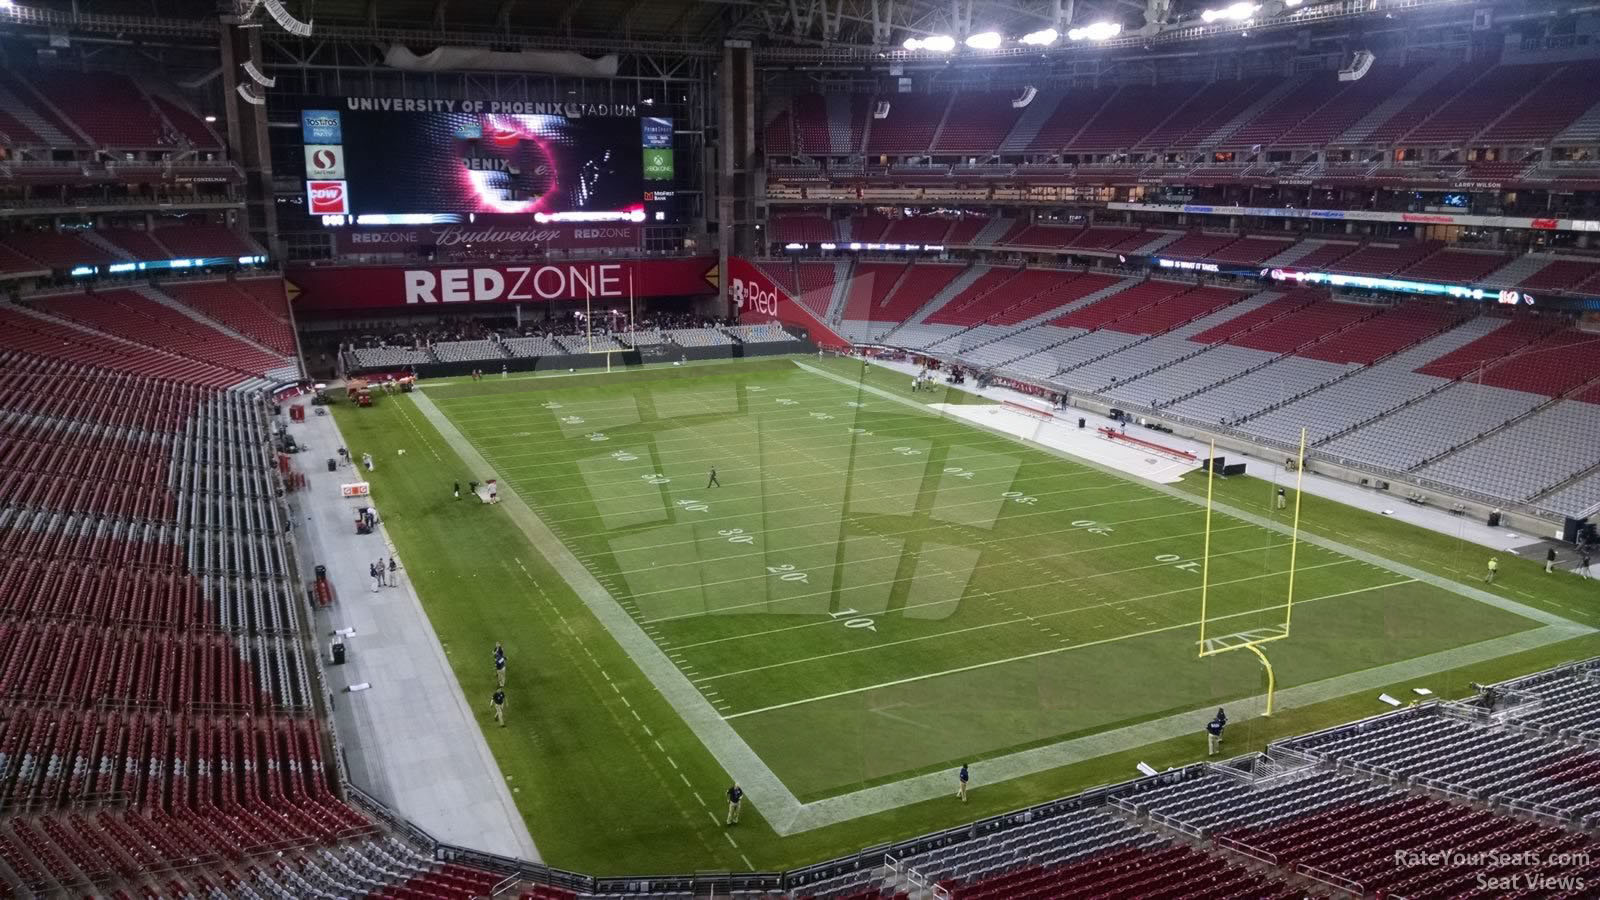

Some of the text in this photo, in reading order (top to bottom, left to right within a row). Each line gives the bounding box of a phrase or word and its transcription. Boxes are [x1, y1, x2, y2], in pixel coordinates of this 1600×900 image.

[347, 97, 455, 112] UNIVERSITY
[462, 101, 483, 113] OF
[491, 101, 562, 114] PHOENIX
[431, 224, 560, 247] Budweiser
[404, 264, 622, 304] REDZONE
[749, 280, 778, 317] Red
[766, 564, 809, 583] 20
[828, 607, 877, 631] 10
